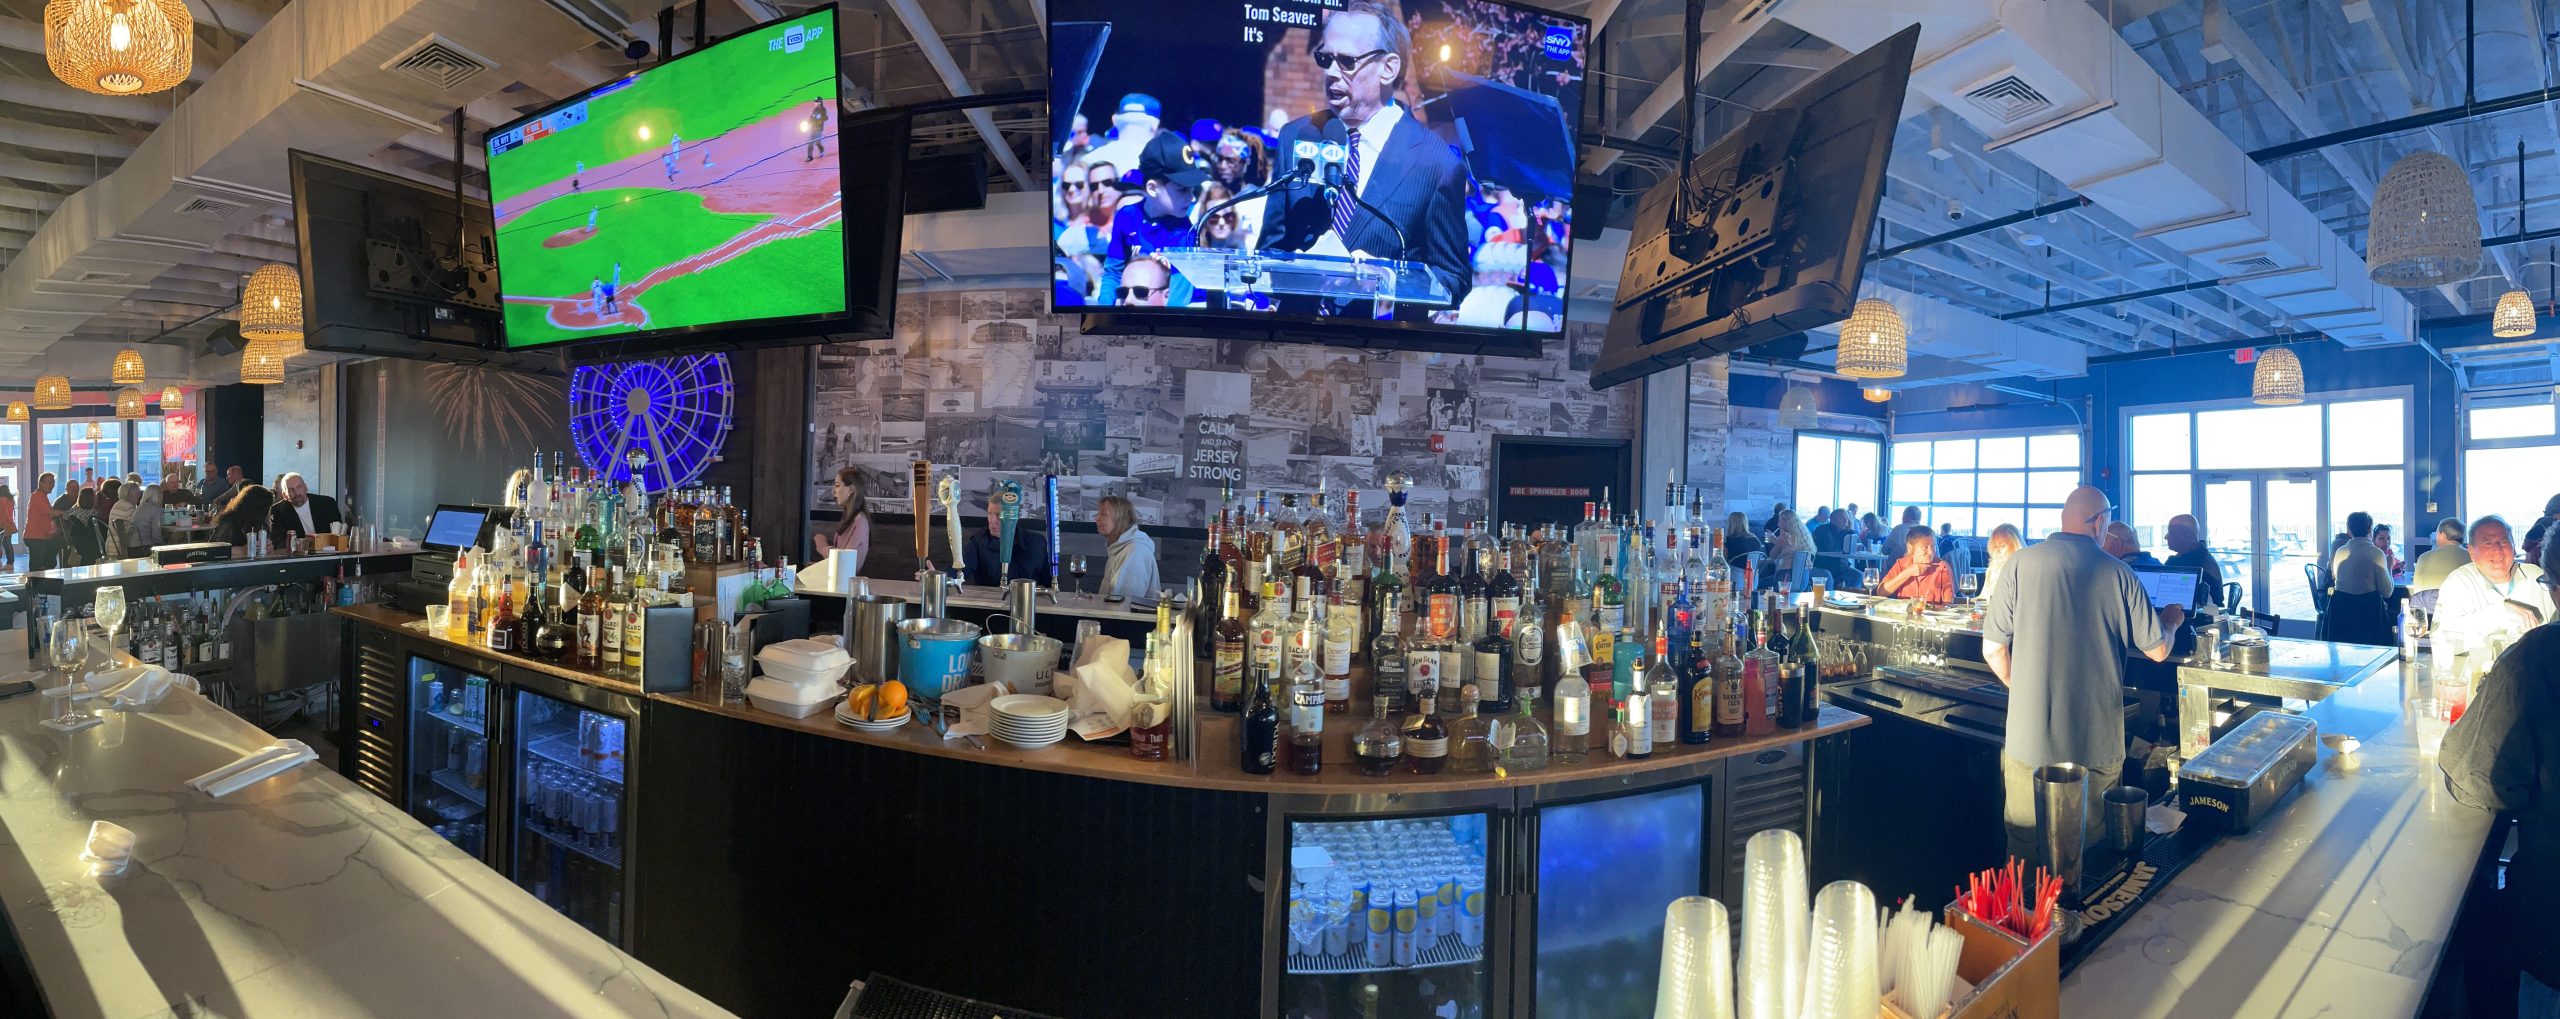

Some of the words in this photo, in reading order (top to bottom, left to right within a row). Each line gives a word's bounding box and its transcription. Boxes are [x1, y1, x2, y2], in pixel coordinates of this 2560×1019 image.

[1244, 4, 1269, 20] Tom
[1272, 7, 1317, 26] Seaver.
[768, 37, 783, 51] THE
[806, 27, 823, 41] APP
[1243, 26, 1263, 42] It's
[1547, 35, 1567, 47] SNY
[1547, 45, 1558, 53] THE
[1182, 145, 1194, 164] C
[1201, 404, 1233, 418] KEEP
[1199, 421, 1236, 435] CALM
[1200, 438, 1215, 446] AND
[1216, 438, 1233, 446] STAY
[1193, 449, 1238, 464] JERSEY
[1189, 465, 1241, 481] STRONG
[1510, 487, 1526, 495] FIRE
[1528, 488, 1567, 496] SPRINKLER
[1570, 488, 1590, 496] ROOM
[186, 550, 207, 559] JAMESON
[1379, 665, 1405, 673] Williams
[2189, 796, 2228, 813] JAMESON
